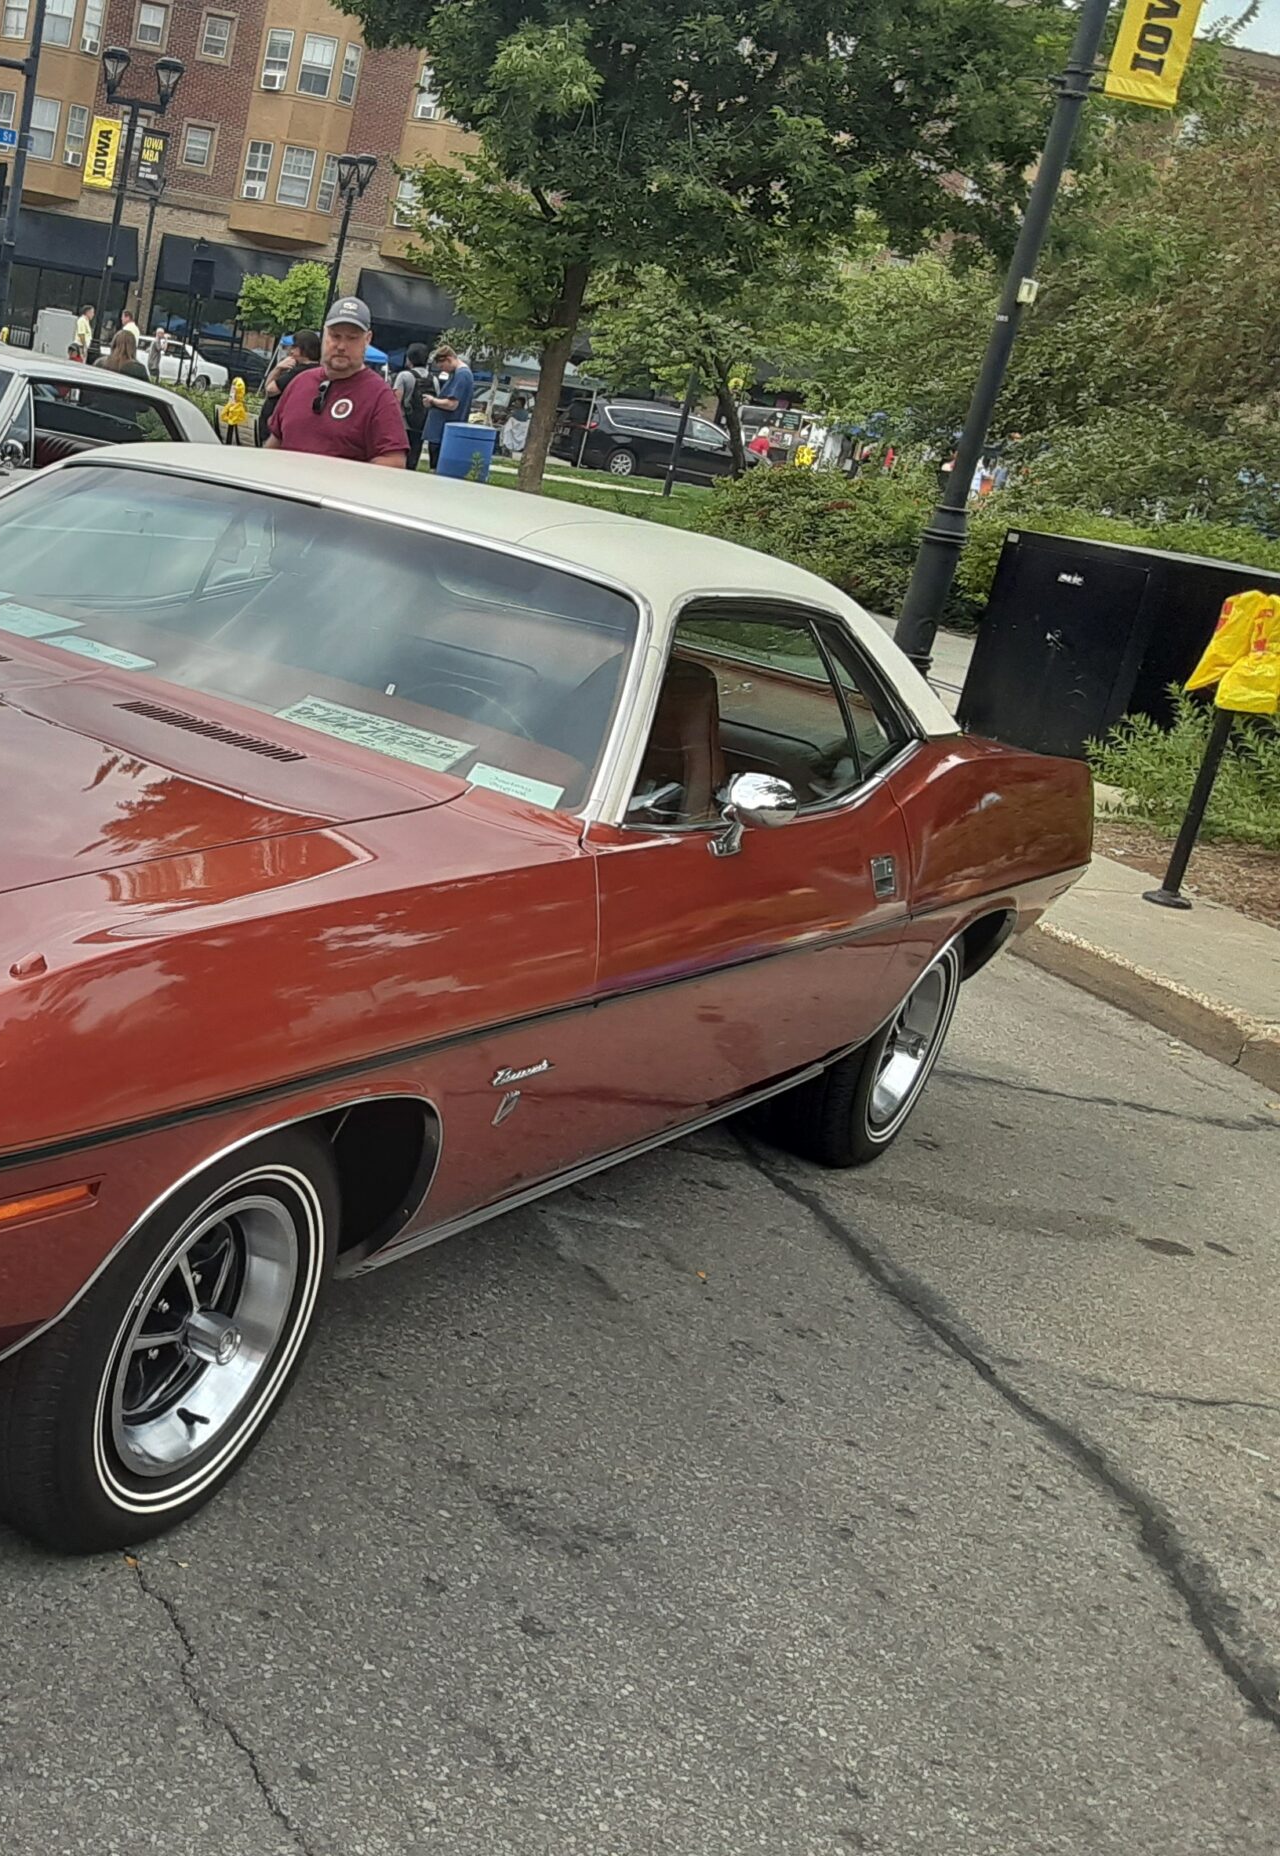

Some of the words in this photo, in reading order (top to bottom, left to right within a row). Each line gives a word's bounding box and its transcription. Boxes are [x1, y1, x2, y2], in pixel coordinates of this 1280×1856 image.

[3, 131, 13, 142] St
[144, 136, 163, 151] IOWA
[92, 128, 113, 178] IOWA
[142, 149, 159, 163] MBA
